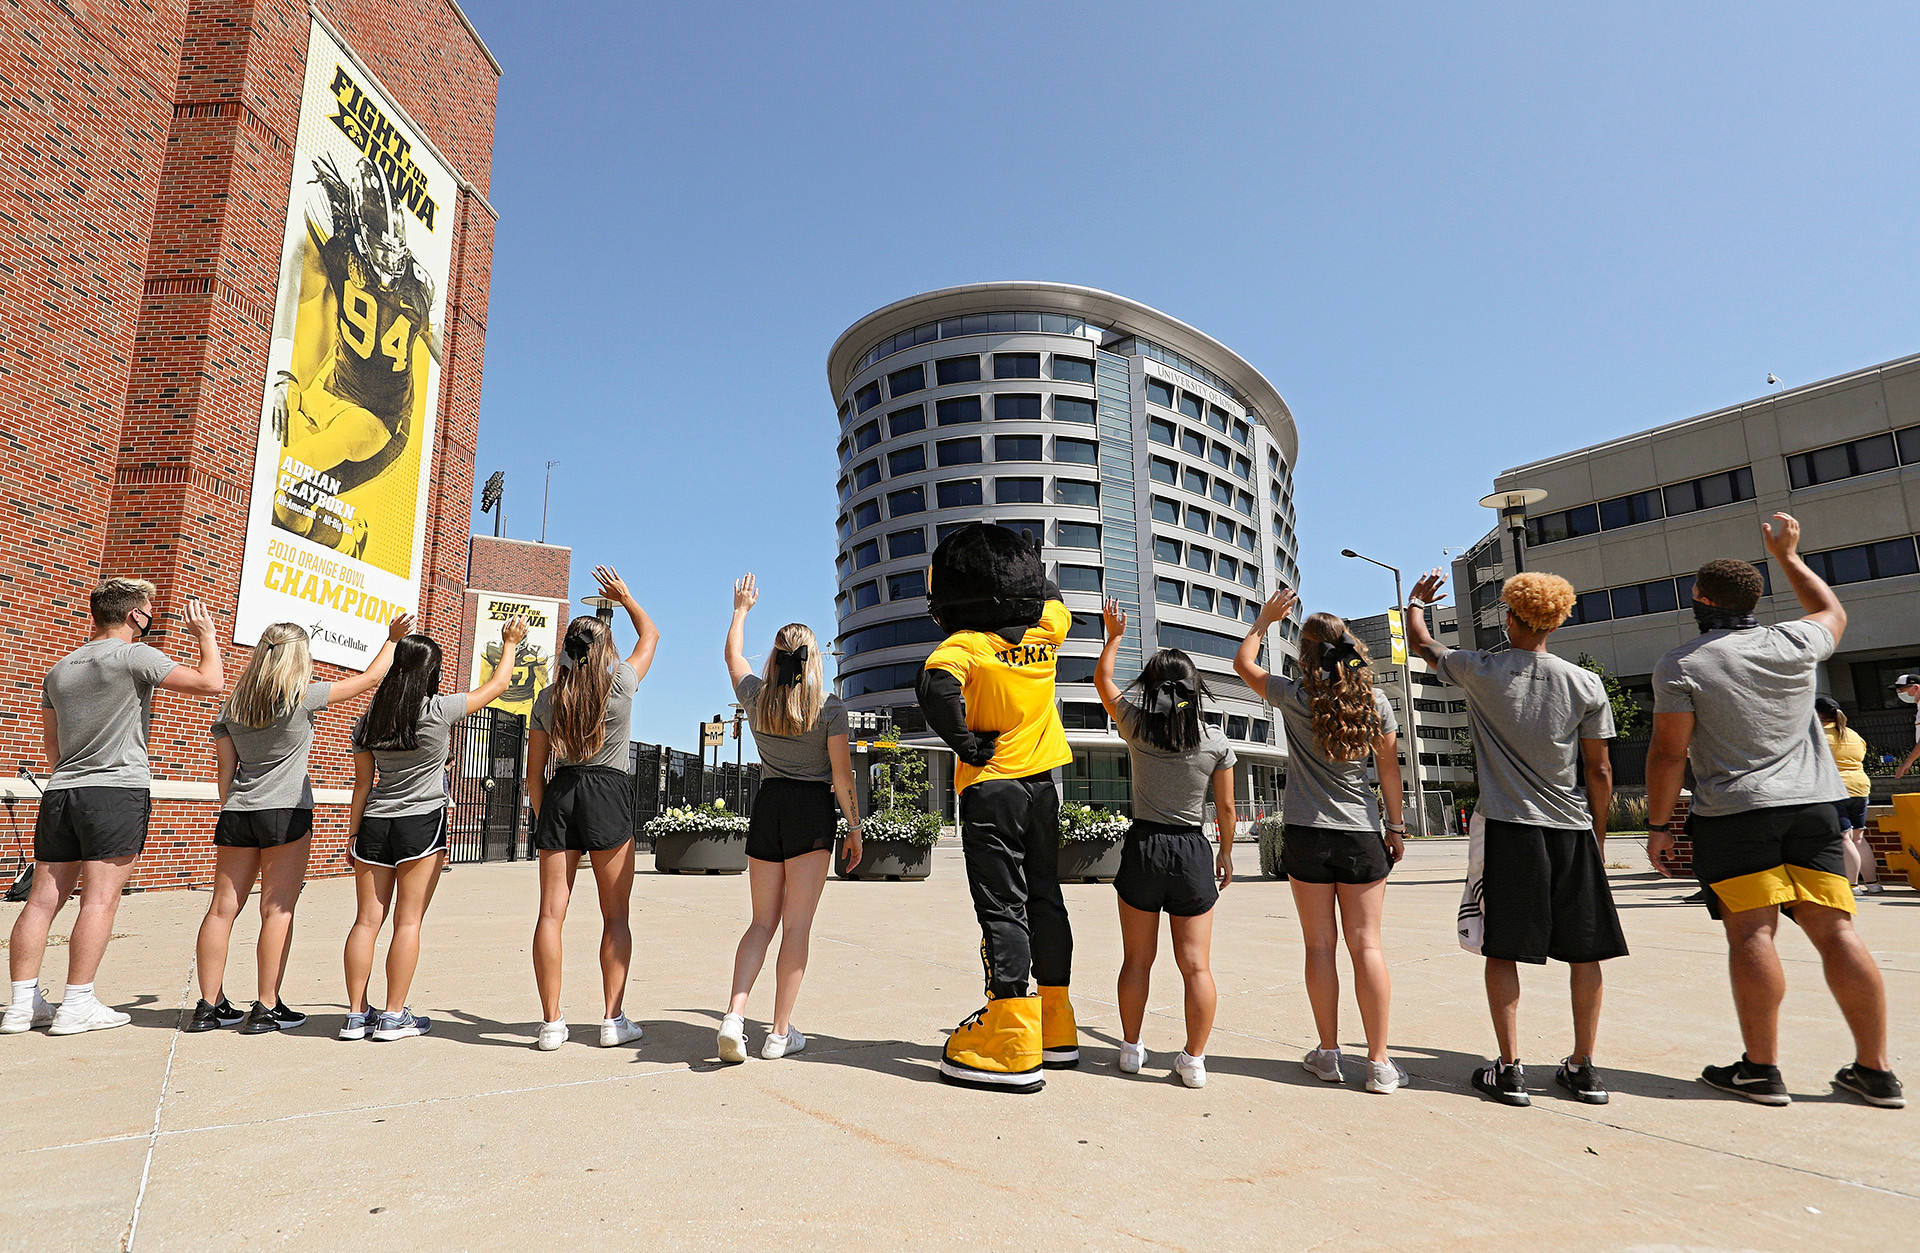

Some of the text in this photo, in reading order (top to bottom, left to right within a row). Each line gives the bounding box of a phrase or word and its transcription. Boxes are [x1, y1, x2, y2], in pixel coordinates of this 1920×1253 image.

[329, 65, 412, 161] FIGHT
[368, 137, 436, 232] IOWA
[405, 158, 428, 190] FOR
[340, 279, 412, 372] 94
[1157, 365, 1208, 397] UNIVERSITY
[278, 474, 356, 520] CLAYBORN
[280, 456, 341, 496] ADRIAN
[276, 494, 354, 536] All-American All-Big Ten
[267, 539, 365, 589] 2010 ORANGE BOWL
[488, 601, 530, 614] FIGHT
[338, 634, 368, 652] Cellular
